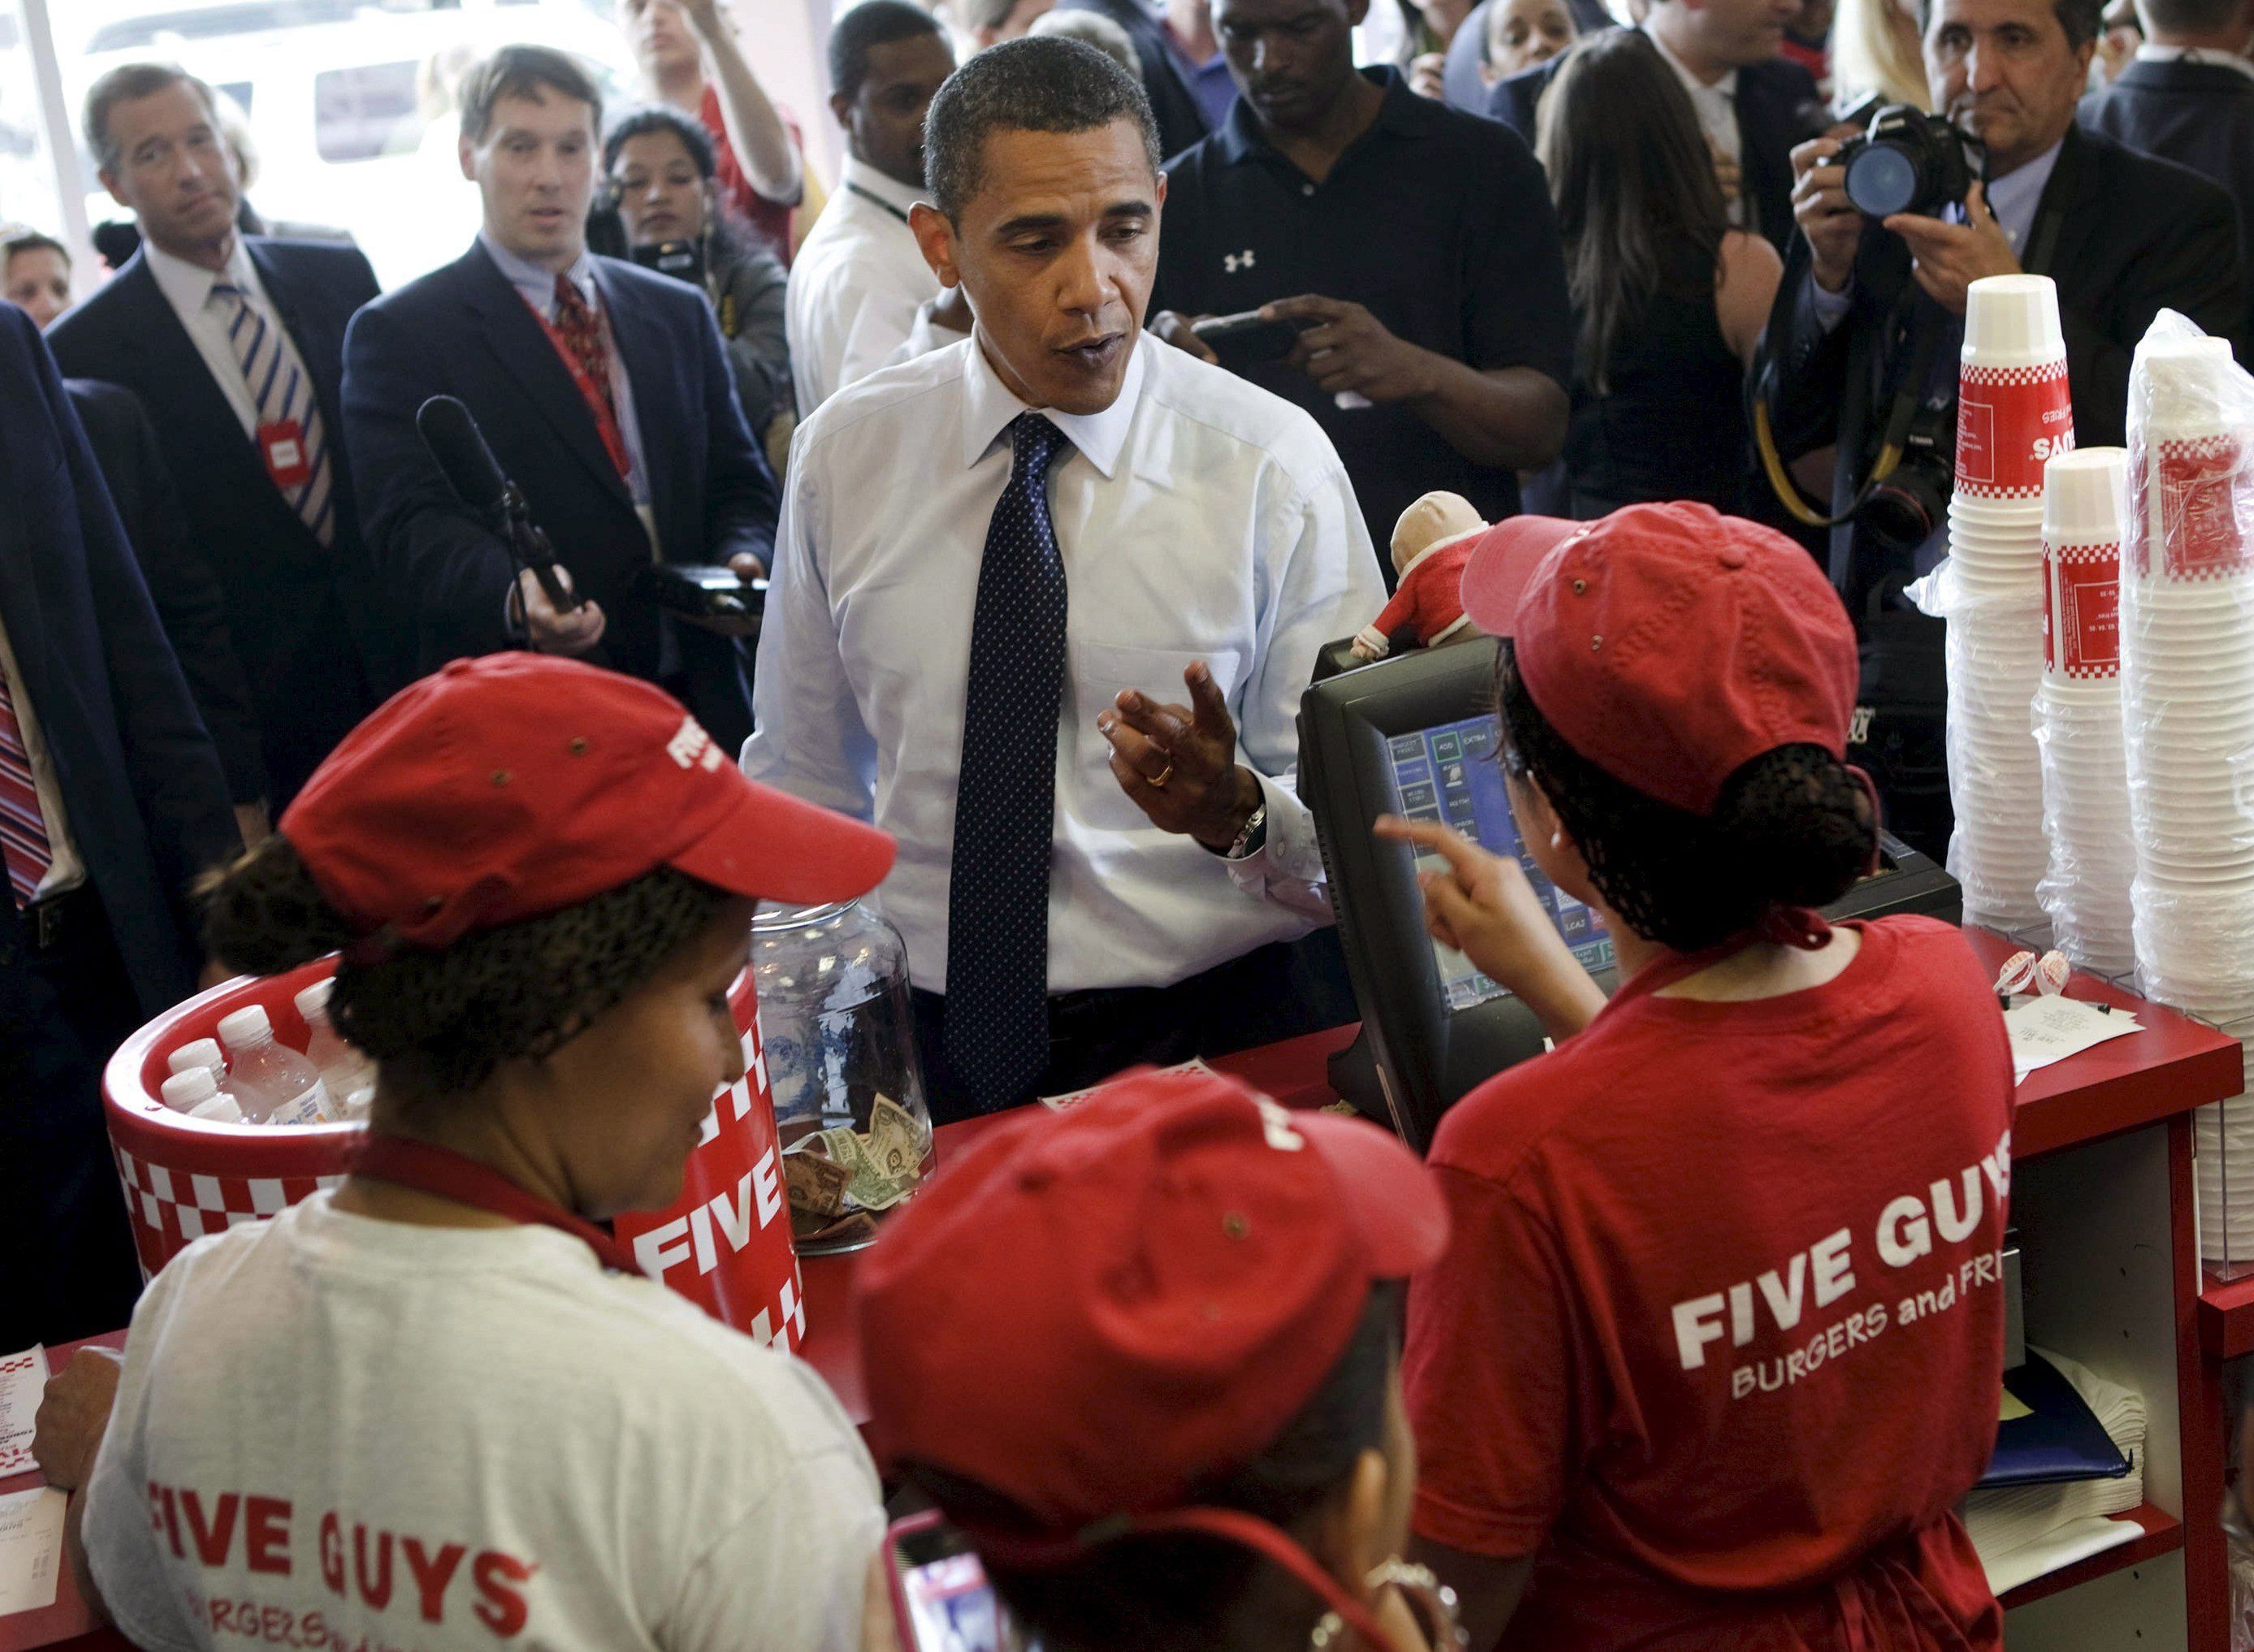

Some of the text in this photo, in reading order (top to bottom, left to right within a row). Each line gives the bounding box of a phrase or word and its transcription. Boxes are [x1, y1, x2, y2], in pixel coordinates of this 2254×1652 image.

[2033, 427, 2076, 461] UYS
[632, 1144, 782, 1287] FIVE
[1671, 1226, 1857, 1371] FIVE
[1732, 1249, 2002, 1400] BURGERS and FRI
[319, 1511, 536, 1638] GUYS
